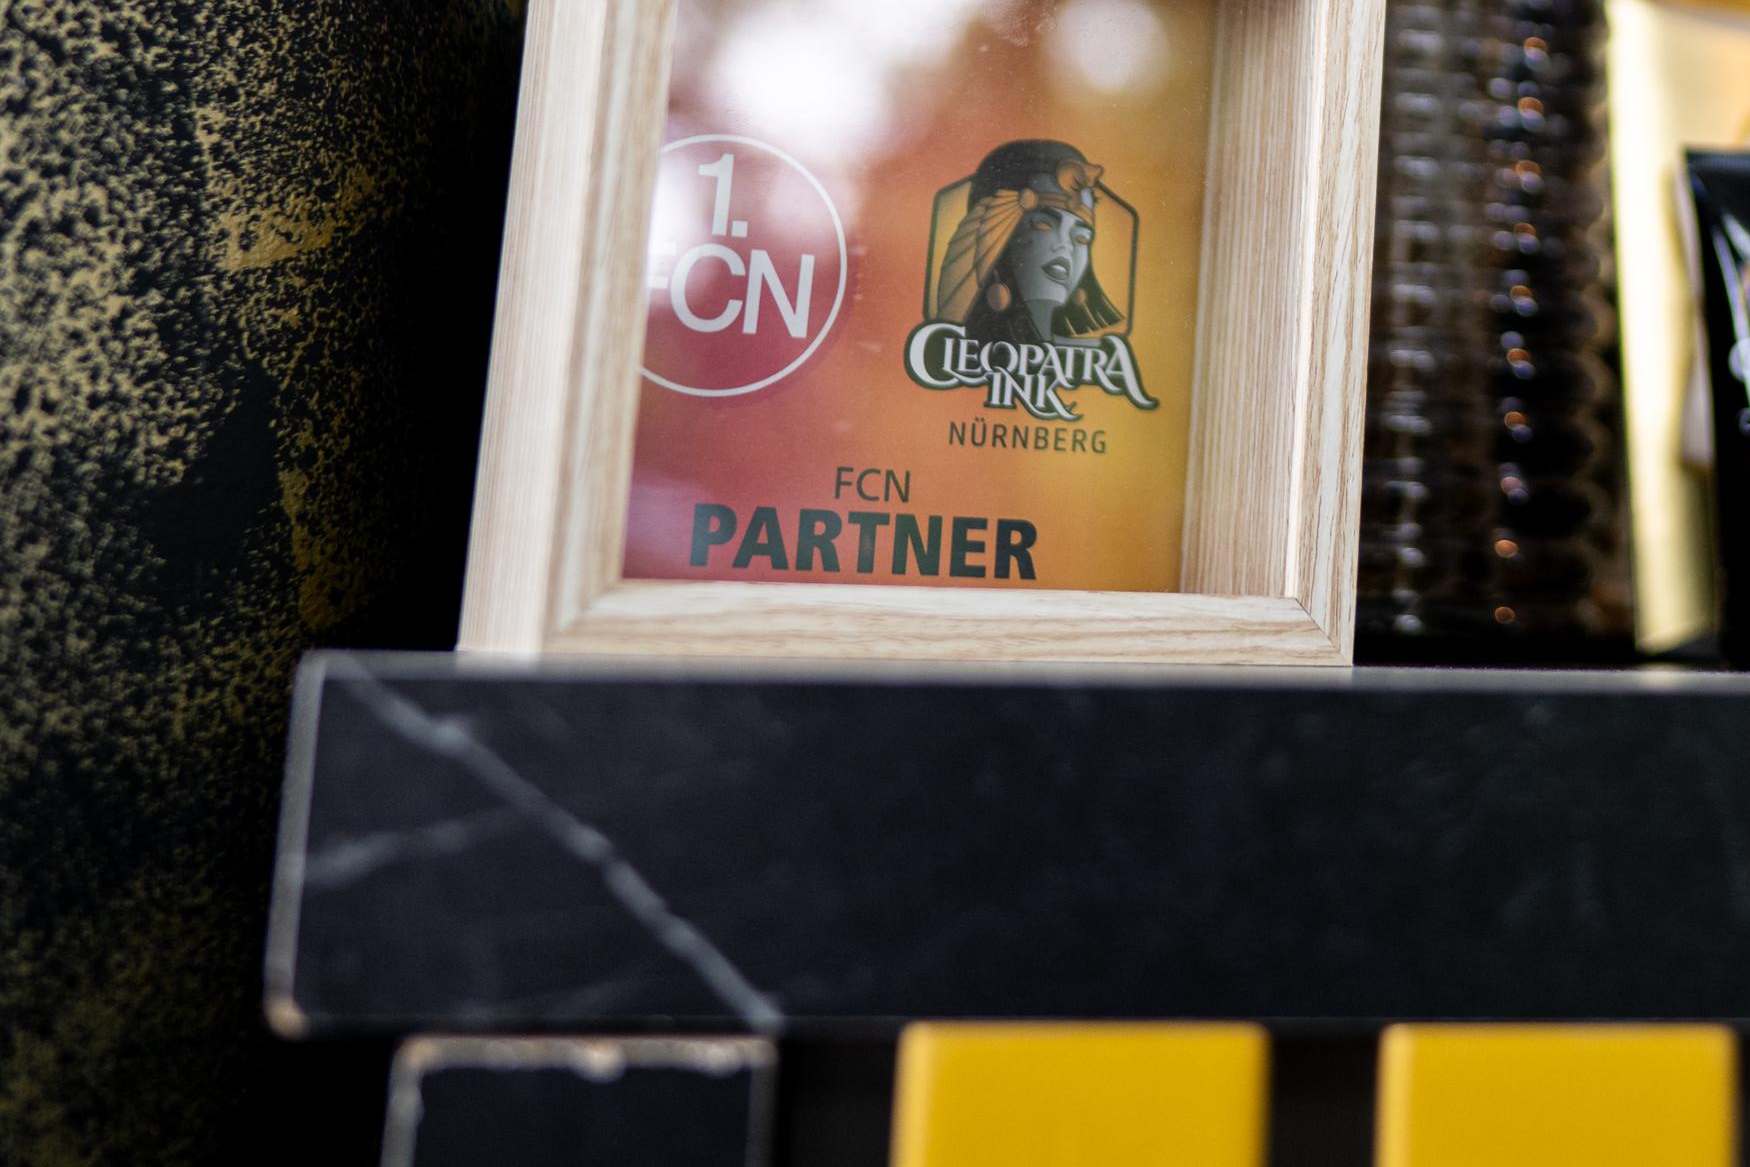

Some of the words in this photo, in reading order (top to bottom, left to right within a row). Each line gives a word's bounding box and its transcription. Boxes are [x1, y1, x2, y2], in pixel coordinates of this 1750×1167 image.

[699, 153, 748, 237] 1.
[908, 323, 1159, 407] CLEOPATRA
[984, 366, 1082, 420] INK
[949, 418, 1107, 453] NÜRNBERG
[834, 467, 911, 502] FCN
[689, 503, 1038, 580] PARTNER
